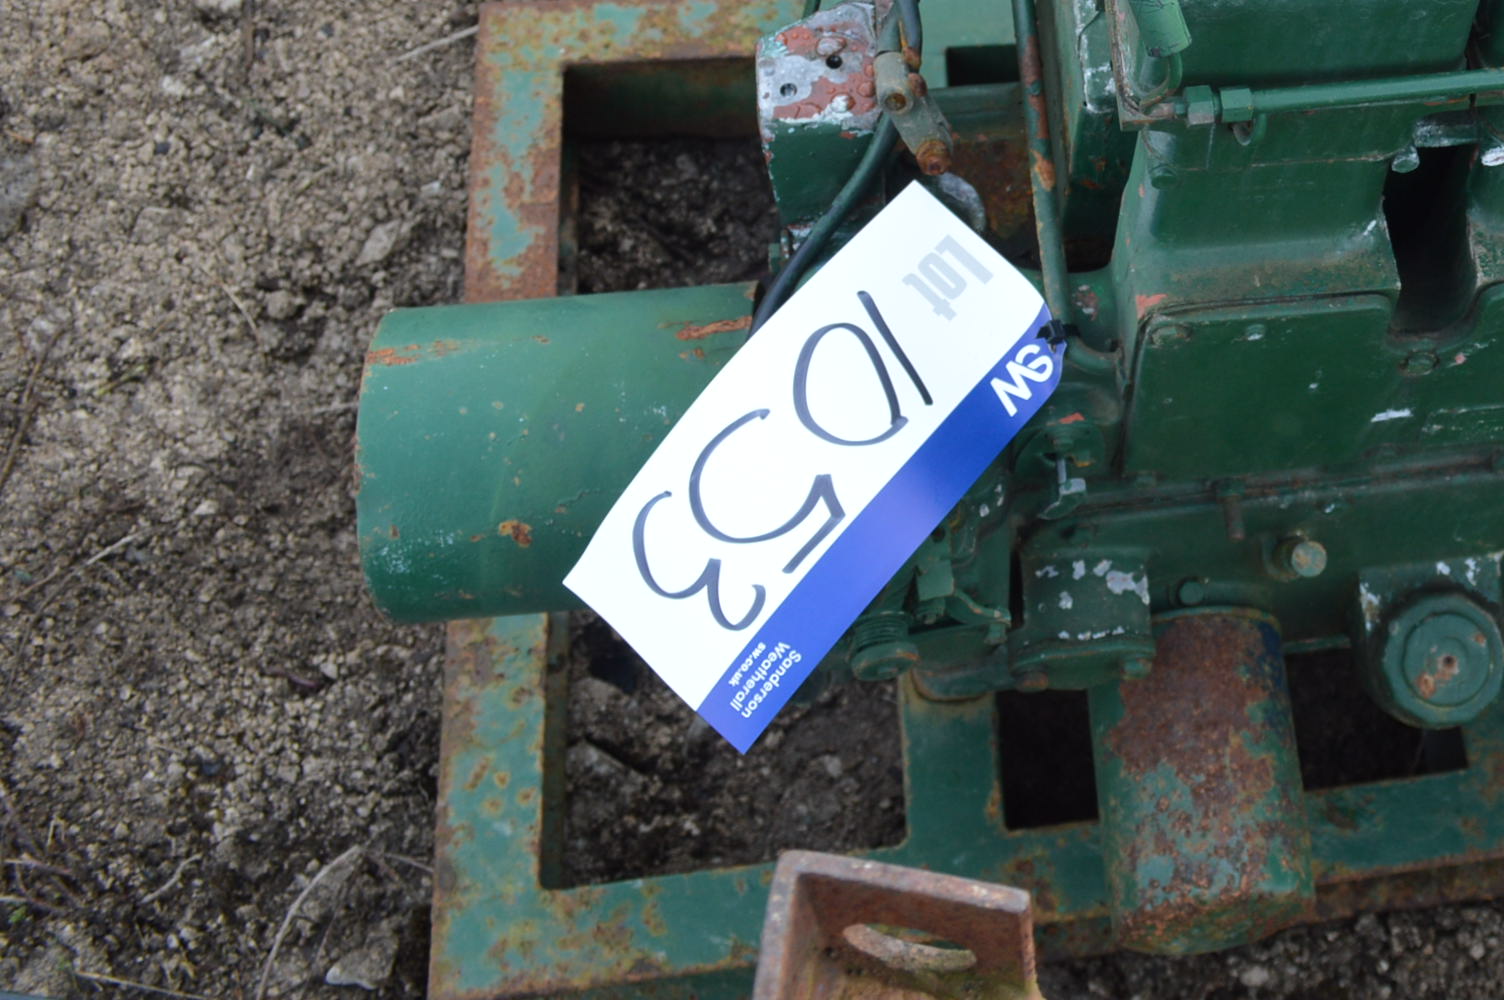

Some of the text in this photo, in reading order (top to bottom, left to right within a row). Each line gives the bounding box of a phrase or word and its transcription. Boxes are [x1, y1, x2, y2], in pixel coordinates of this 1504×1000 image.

[902, 235, 994, 321] Lot
[990, 344, 1053, 417] SW
[632, 291, 934, 631] 1053
[728, 642, 766, 687] sw.co.uk
[730, 642, 791, 711] Weatherall
[741, 650, 802, 718] Sanderson
